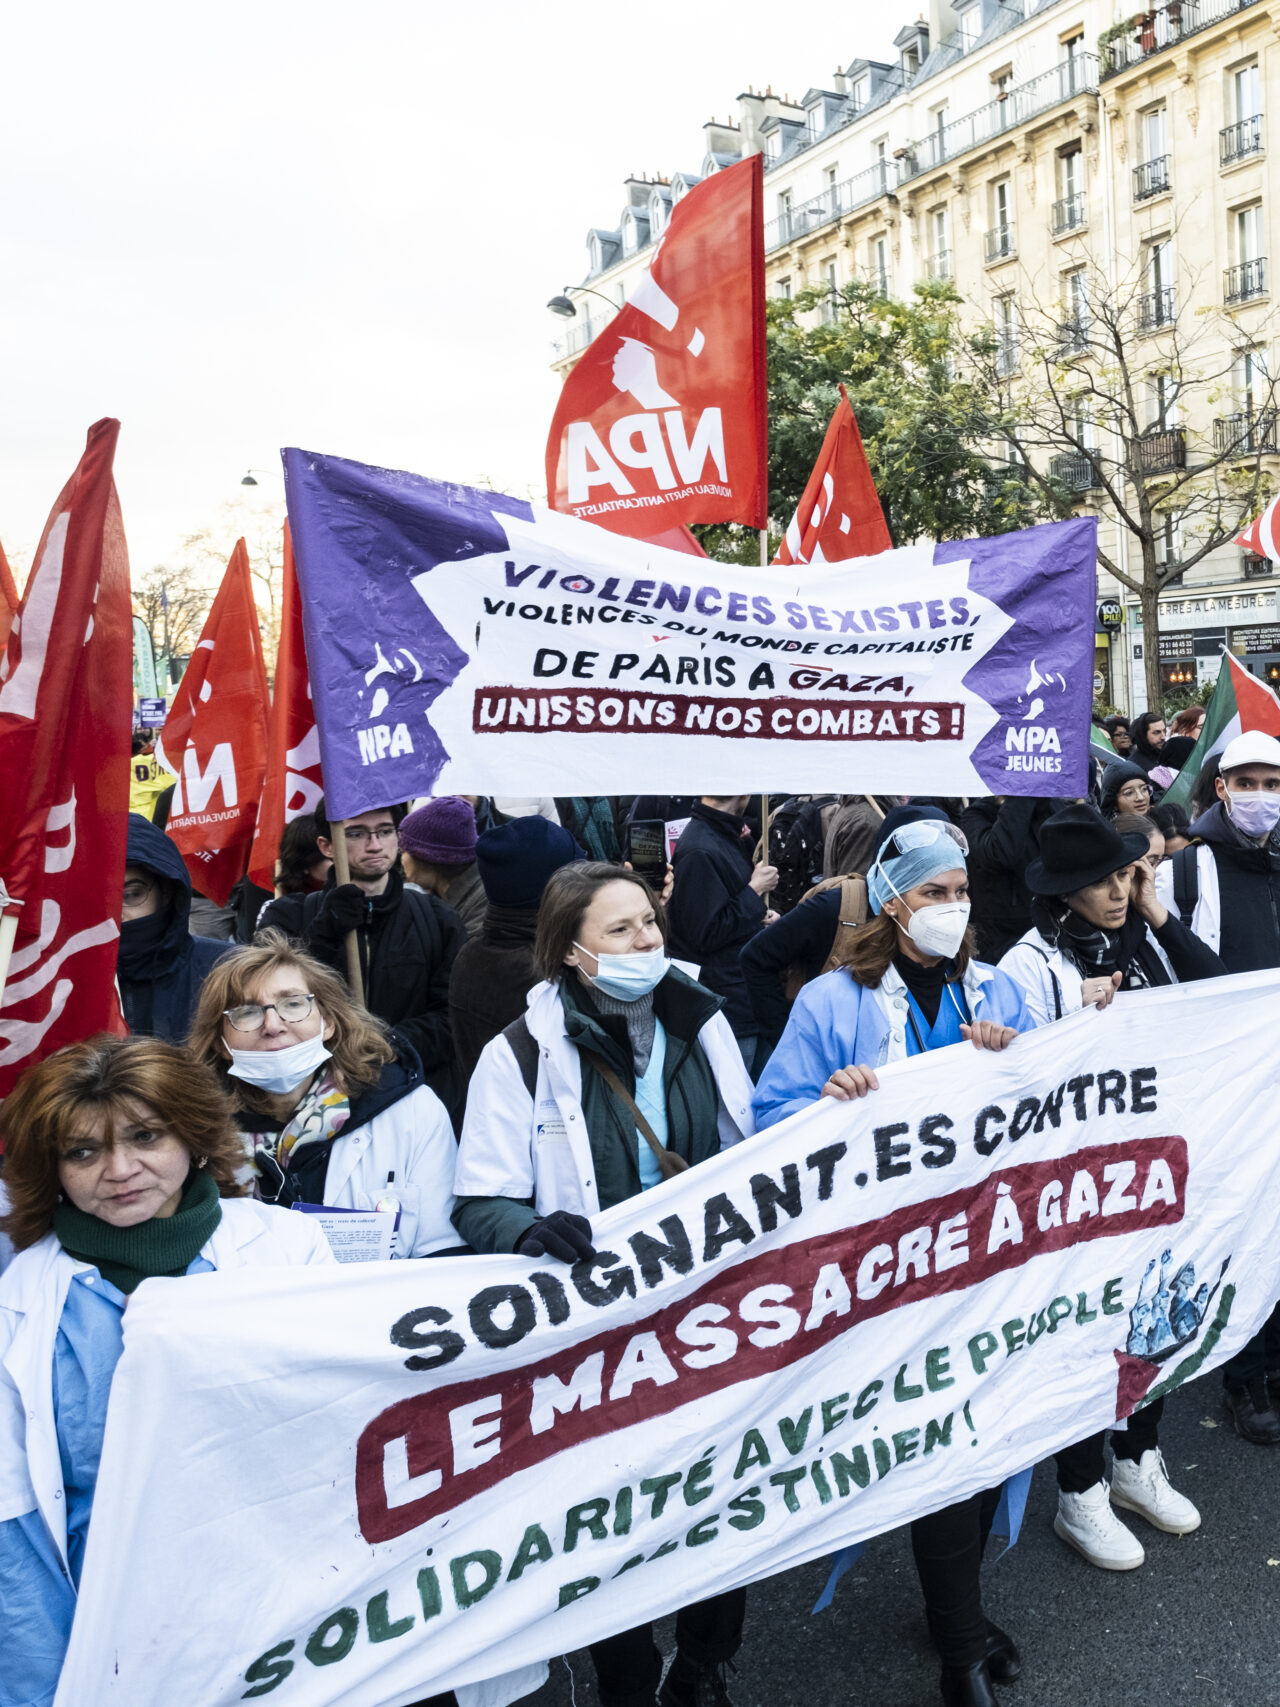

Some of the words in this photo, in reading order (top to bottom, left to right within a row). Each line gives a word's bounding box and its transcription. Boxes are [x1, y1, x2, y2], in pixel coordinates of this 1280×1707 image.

[504, 561, 776, 626] VIOLENCES
[783, 597, 982, 634] SEXISTES,
[1159, 603, 1192, 615] ERRES
[483, 597, 658, 626] VIOLENCES
[662, 621, 708, 636] DU
[711, 631, 819, 655] MONDE
[823, 632, 975, 655] CAPITALISTE
[533, 648, 600, 678] DE
[609, 653, 736, 688] PARIS
[748, 662, 775, 691] A
[788, 669, 915, 698] GAZA,
[479, 695, 676, 727] UNISSONS
[685, 703, 764, 734] NOS
[771, 707, 941, 736] COMBATS
[1005, 726, 1063, 755] NPA
[357, 723, 415, 766] NPA
[1005, 755, 1063, 774] JEUNES
[391, 1113, 957, 1371] SOIGNANT.ES
[974, 1067, 1158, 1156] CONTRE
[382, 1394, 502, 1509] LE
[530, 1217, 970, 1437] MASSACRE
[987, 1181, 1023, 1254] À
[1037, 1157, 1177, 1231] GAZA
[242, 1445, 718, 1699] SOLIDARITÉ
[733, 1378, 885, 1480] AVEC
[894, 1346, 957, 1403] LE
[967, 1277, 1126, 1376] PEUPLE
